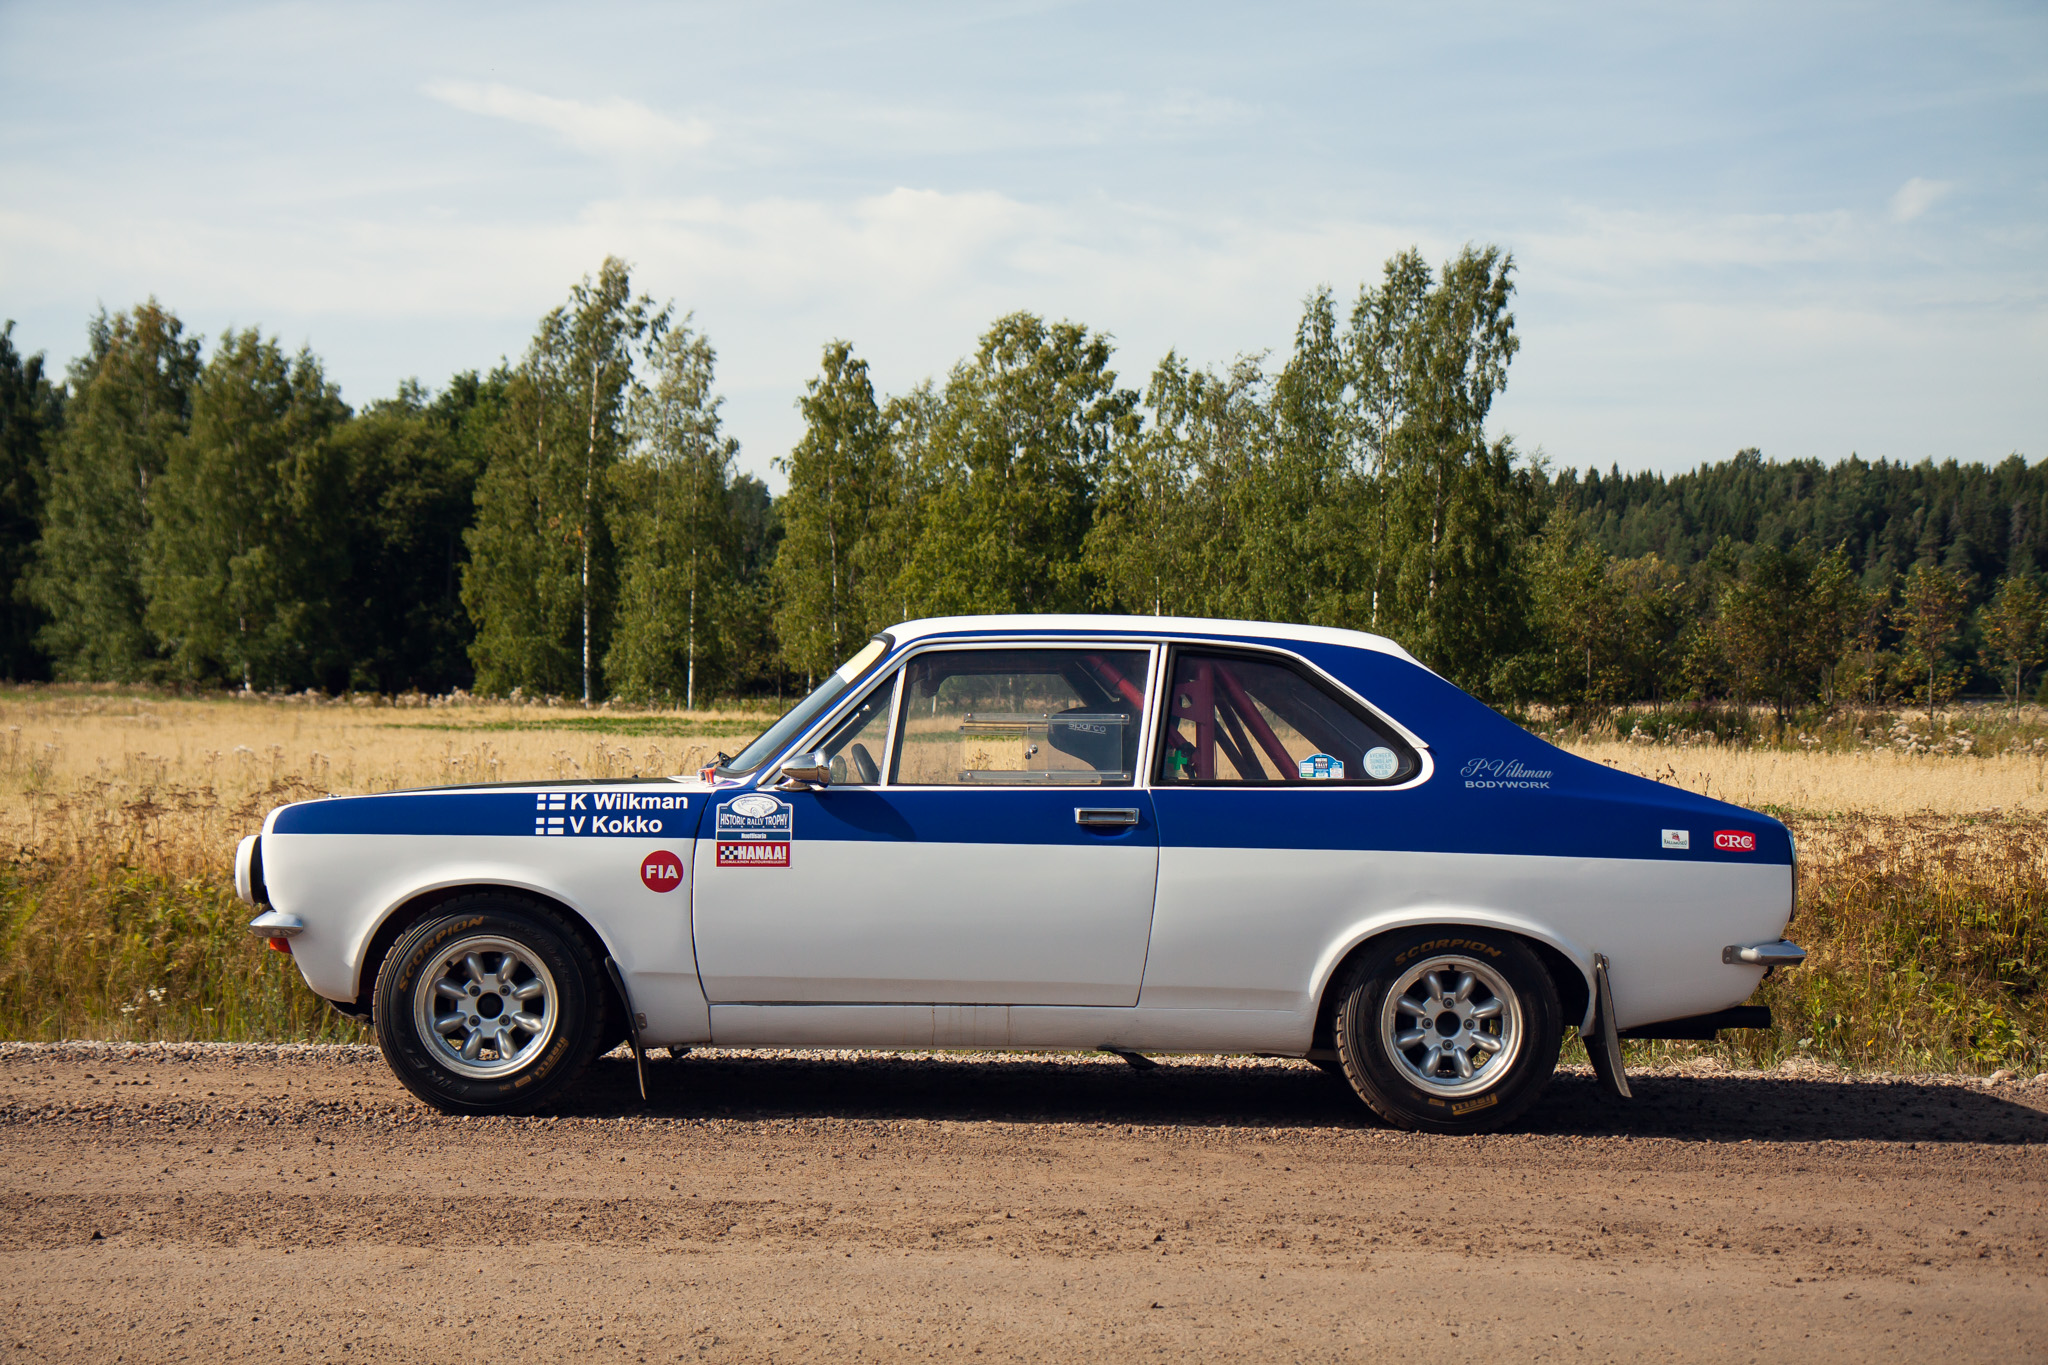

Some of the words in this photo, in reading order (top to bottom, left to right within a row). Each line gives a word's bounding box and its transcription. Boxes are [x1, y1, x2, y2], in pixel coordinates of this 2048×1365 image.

[1068, 721, 1106, 733] sparco
[1464, 780, 1551, 789] BODYWORK
[570, 793, 588, 810] K
[593, 793, 689, 810] Wilkman
[569, 815, 586, 833] V
[591, 815, 663, 834] Kokko
[720, 813, 746, 826] HISTORIC
[746, 817, 764, 826] RALLY
[764, 813, 789, 826] TROPHY
[1715, 834, 1753, 849] CRC
[737, 845, 787, 860] HANAA!
[646, 865, 679, 879] FIA
[399, 915, 485, 992] SCORPION
[1394, 938, 1503, 967] SCORPION
[534, 1036, 570, 1079] PIRELLI
[1451, 1093, 1499, 1116] PIRELLI
